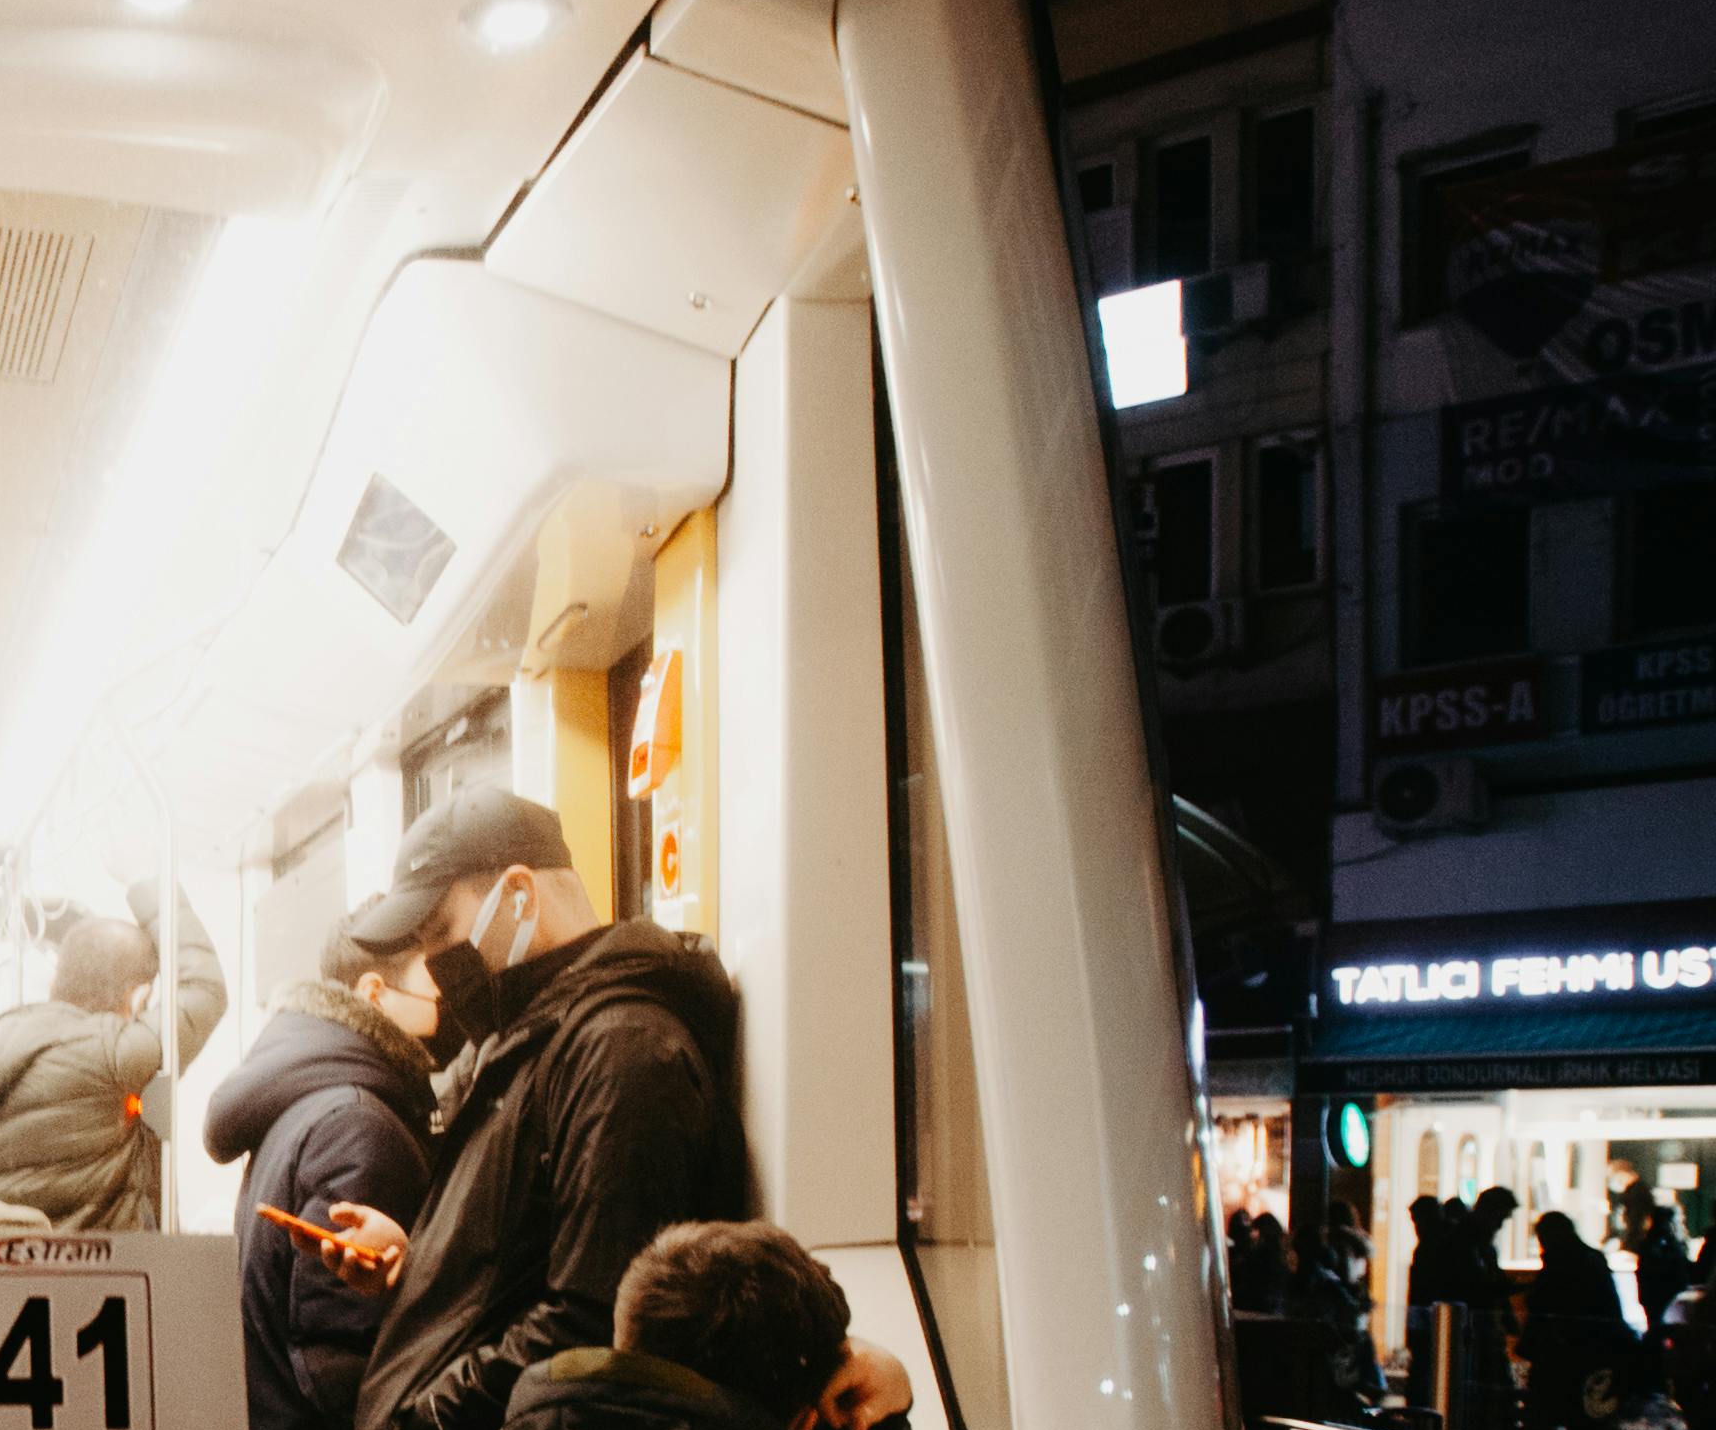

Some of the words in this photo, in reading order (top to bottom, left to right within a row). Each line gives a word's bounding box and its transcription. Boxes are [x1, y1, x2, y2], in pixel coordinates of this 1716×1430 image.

[1636, 645, 1714, 680] KPSS
[1378, 680, 1536, 738] KPSS-A
[1331, 961, 1480, 1004] TATLICI
[1643, 946, 1716, 989] US
